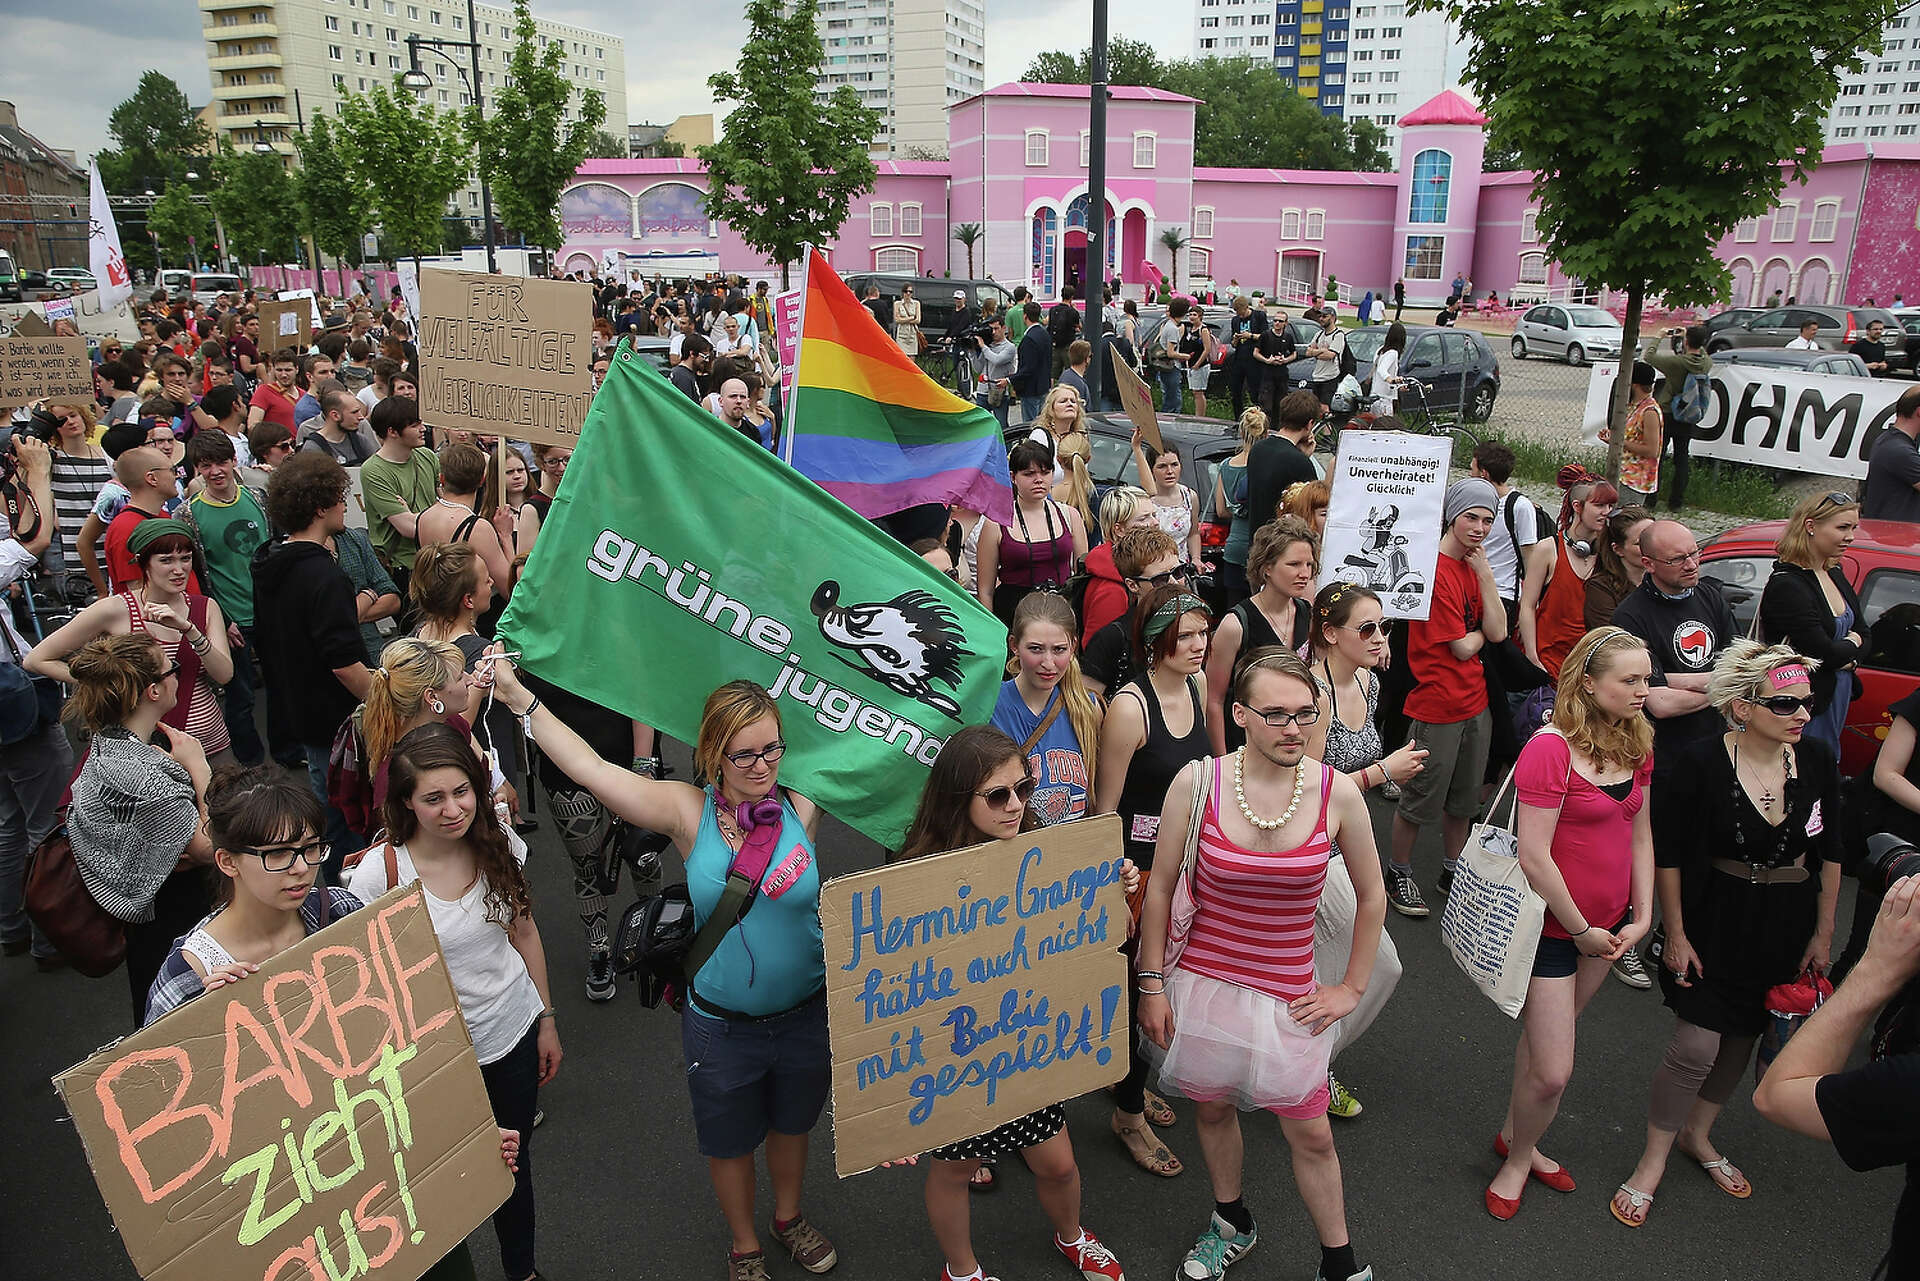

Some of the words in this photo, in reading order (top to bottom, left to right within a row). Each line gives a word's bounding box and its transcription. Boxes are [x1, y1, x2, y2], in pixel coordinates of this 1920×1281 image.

[466, 281, 530, 323] FÜR
[37, 343, 65, 355] wollte
[41, 358, 65, 368] wenn
[68, 355, 81, 368] sie
[421, 315, 576, 375] VIELFÄLTIGE
[5, 387, 23, 398] was
[26, 384, 43, 397] wird
[47, 372, 62, 380] wie
[1349, 466, 1435, 483] Unverheiratet!
[1366, 483, 1415, 495] Glücklich!
[585, 528, 793, 656] grüne
[1045, 748, 1089, 790] YOR
[841, 885, 1010, 971] Hermine
[855, 956, 961, 1025] hätte
[967, 925, 1032, 984] auch
[1038, 904, 1109, 961] nicht
[95, 891, 457, 1203] BARBIE
[857, 1026, 927, 1091] mit
[940, 988, 1053, 1058] Barbie
[909, 984, 1122, 1127] gespielt!
